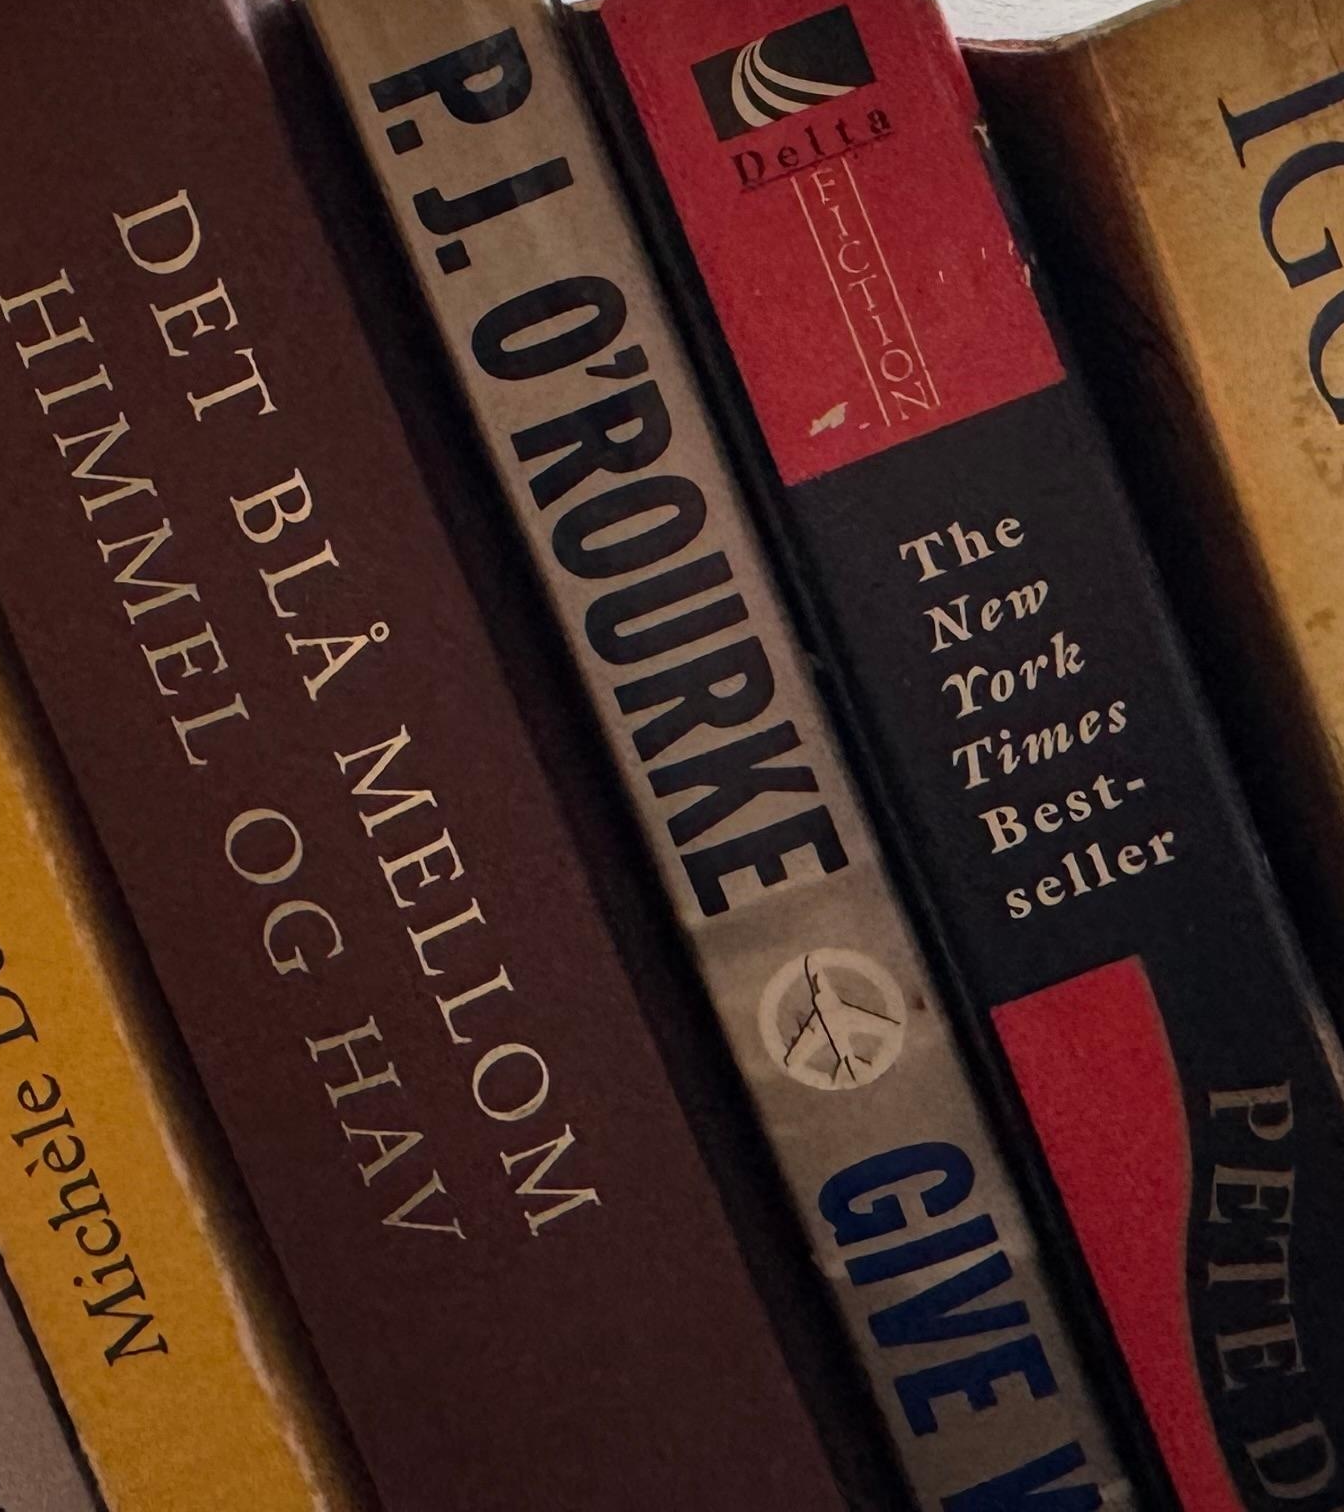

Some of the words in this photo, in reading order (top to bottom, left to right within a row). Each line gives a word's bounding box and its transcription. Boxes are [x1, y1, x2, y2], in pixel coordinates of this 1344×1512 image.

[731, 107, 892, 188] Delta
[811, 168, 931, 420] FICTION
[471, 275, 850, 917] O'ROURKE
[898, 516, 1026, 583] The
[923, 579, 1049, 654] New
[112, 189, 278, 421] DET
[229, 467, 390, 701] BLÅ
[334, 724, 602, 1236] MELLOM
[941, 631, 1086, 719] York
[952, 699, 1129, 790] Times
[978, 774, 1146, 854] Best-
[1005, 830, 1176, 920] seller
[225, 808, 344, 975] OG
[305, 1016, 467, 1240] HAV
[11, 1072, 168, 1367] Michèle
[818, 1141, 1059, 1437] GIVE
[1208, 1079, 1309, 1392] PETE
